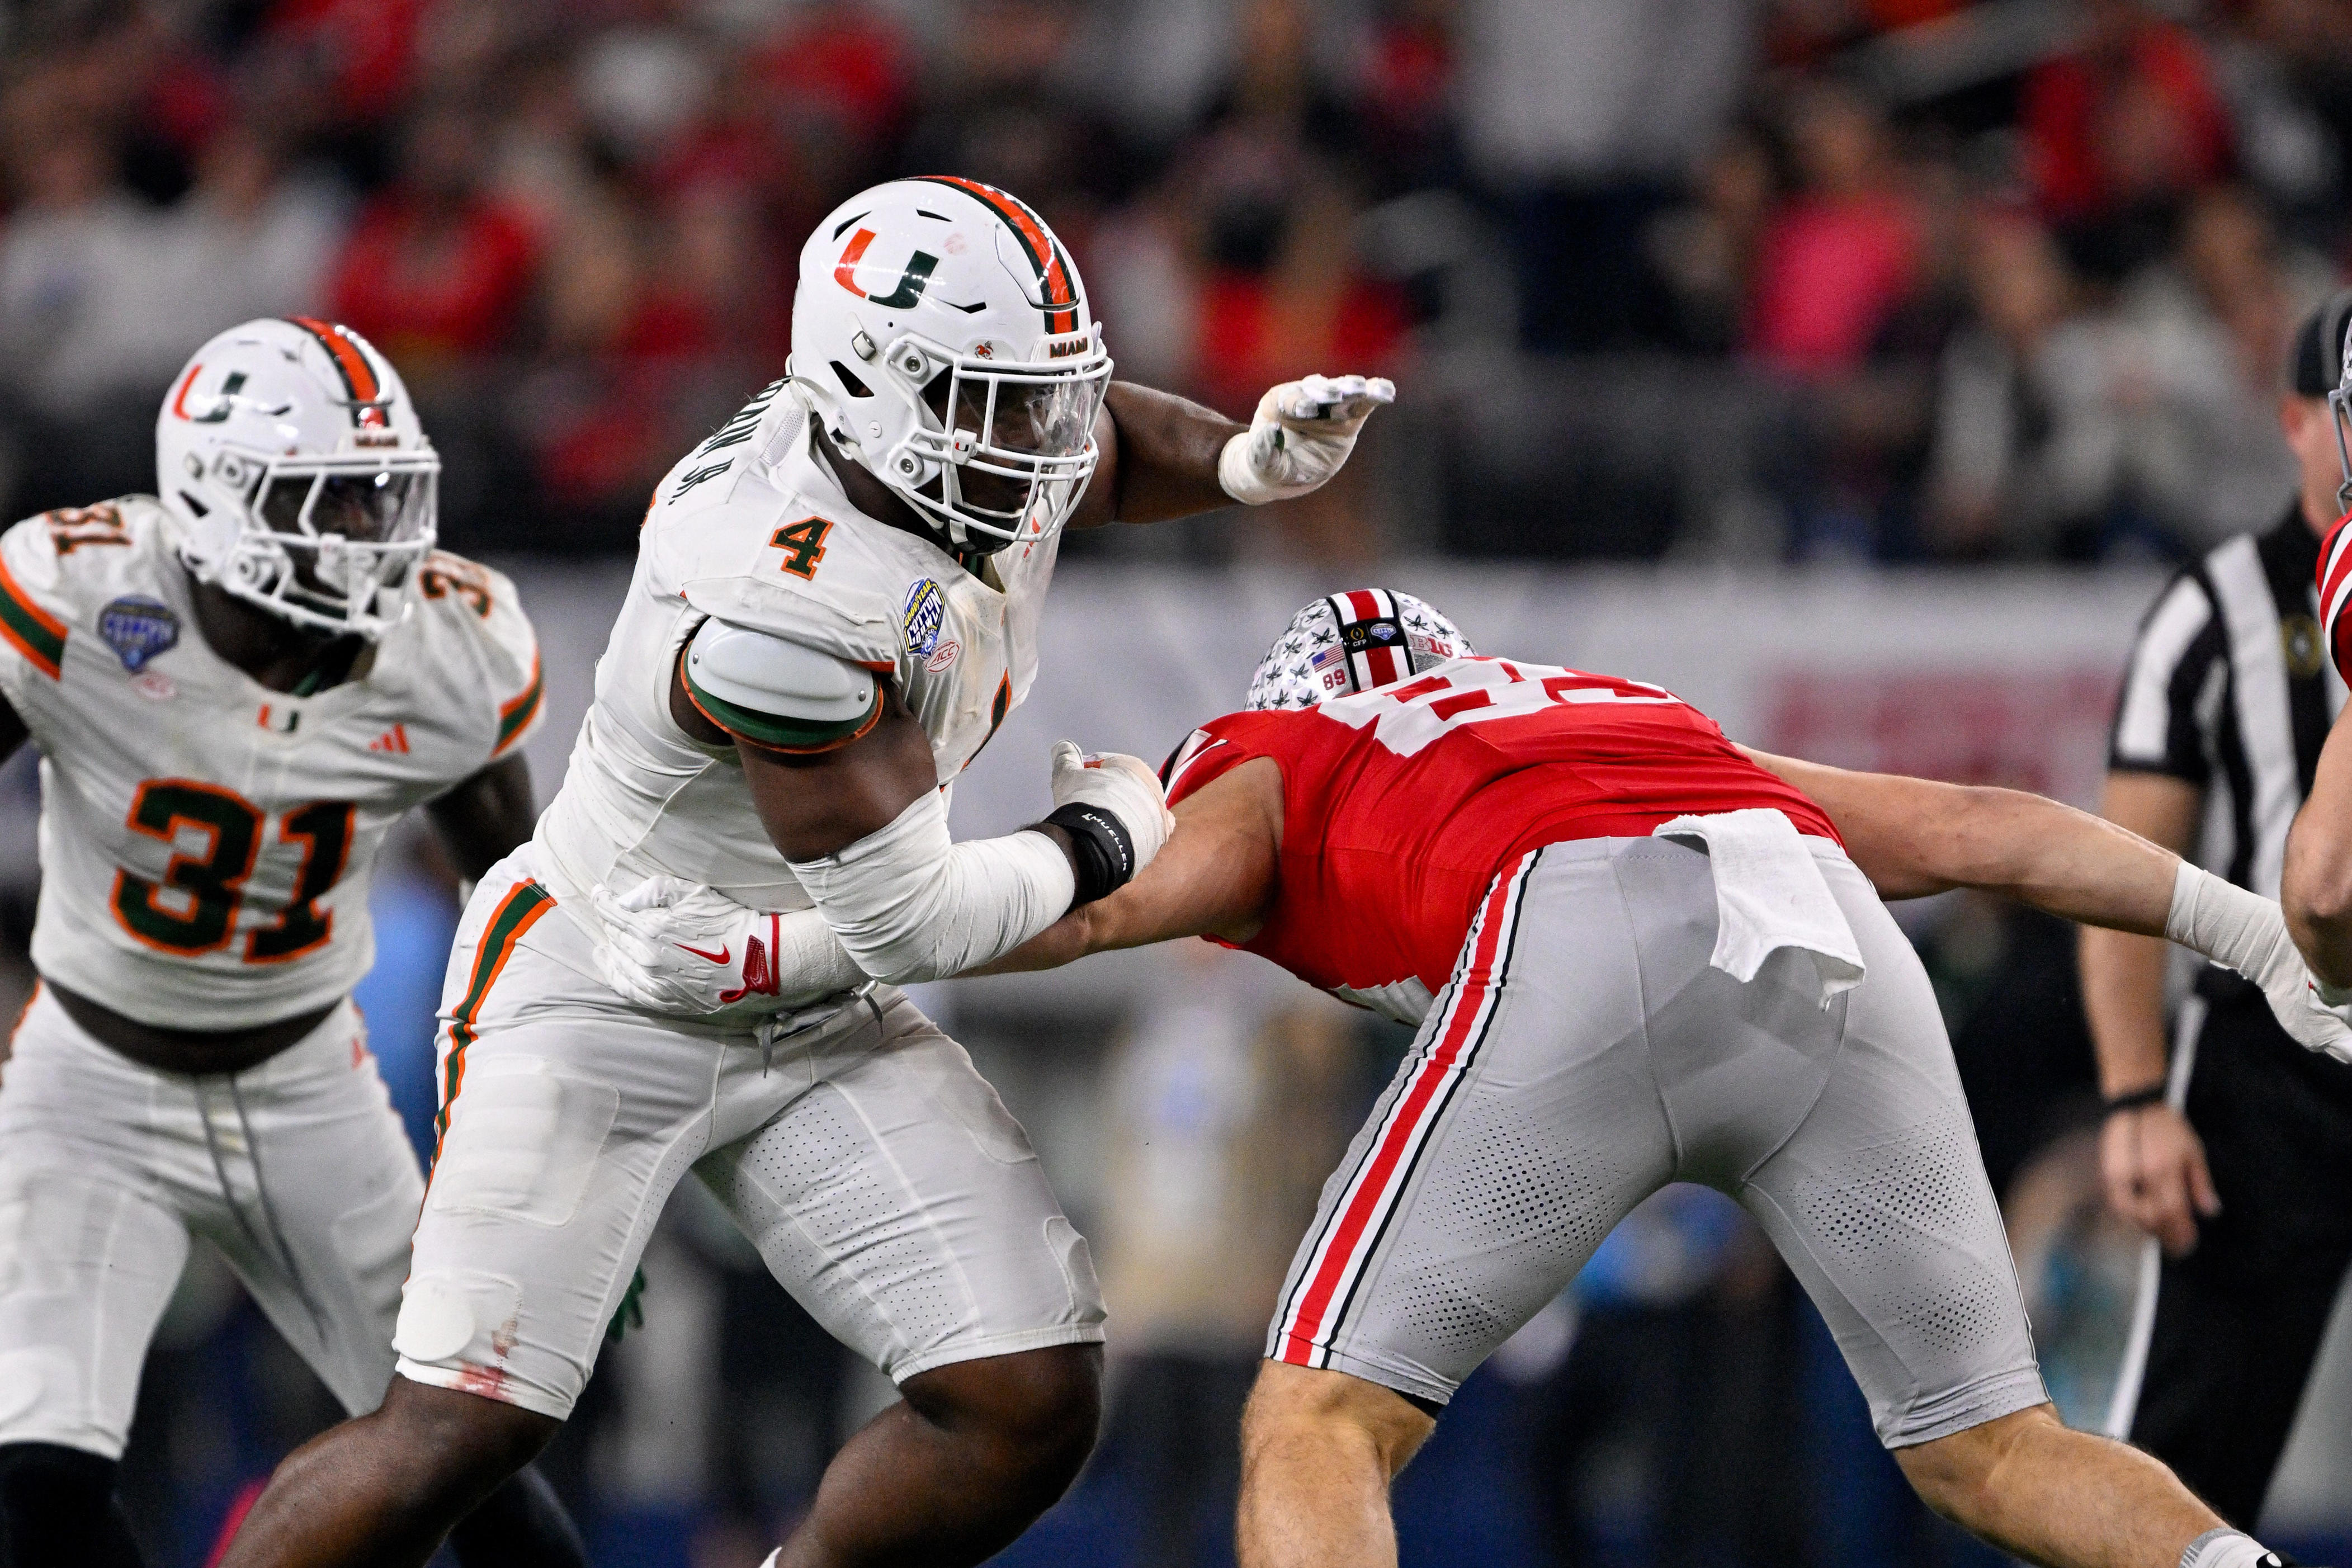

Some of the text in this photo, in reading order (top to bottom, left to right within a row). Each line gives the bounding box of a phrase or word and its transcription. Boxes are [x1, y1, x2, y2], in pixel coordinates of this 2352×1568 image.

[834, 228, 940, 309] U
[1050, 337, 1088, 358] MIAMI
[770, 516, 833, 580] 4
[905, 580, 932, 627] GOODYEAR
[907, 587, 942, 647] COTTON
[916, 610, 940, 644] BOWL
[930, 644, 956, 665] ACC
[1323, 668, 1346, 691] 89
[1090, 814, 1128, 872] MUELLER
[109, 778, 356, 964] 31
